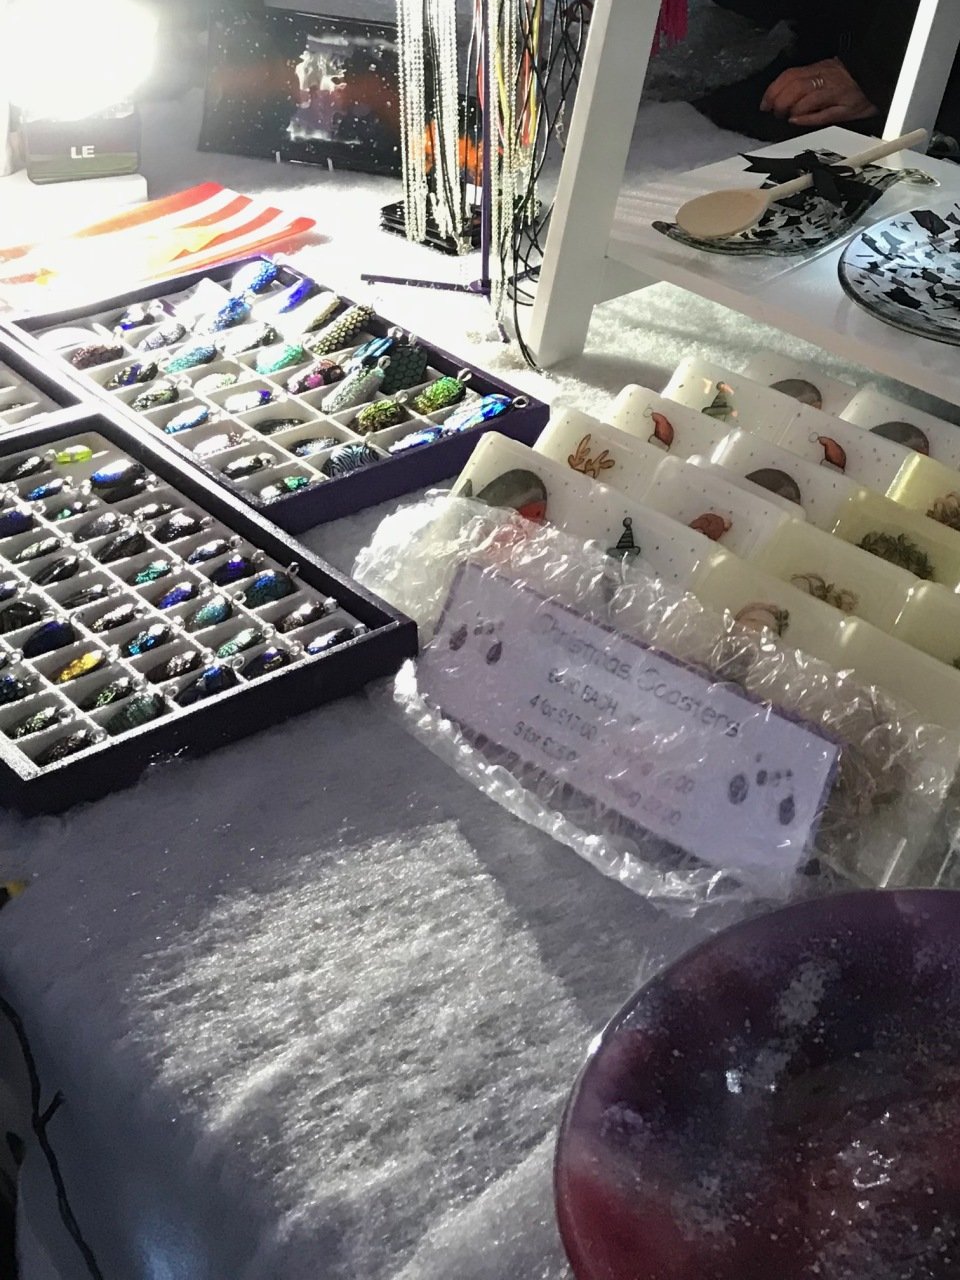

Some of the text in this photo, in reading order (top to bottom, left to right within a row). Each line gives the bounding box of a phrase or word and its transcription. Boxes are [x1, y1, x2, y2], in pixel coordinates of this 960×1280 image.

[70, 145, 96, 159] LE
[537, 611, 741, 738] Christmas Coasters
